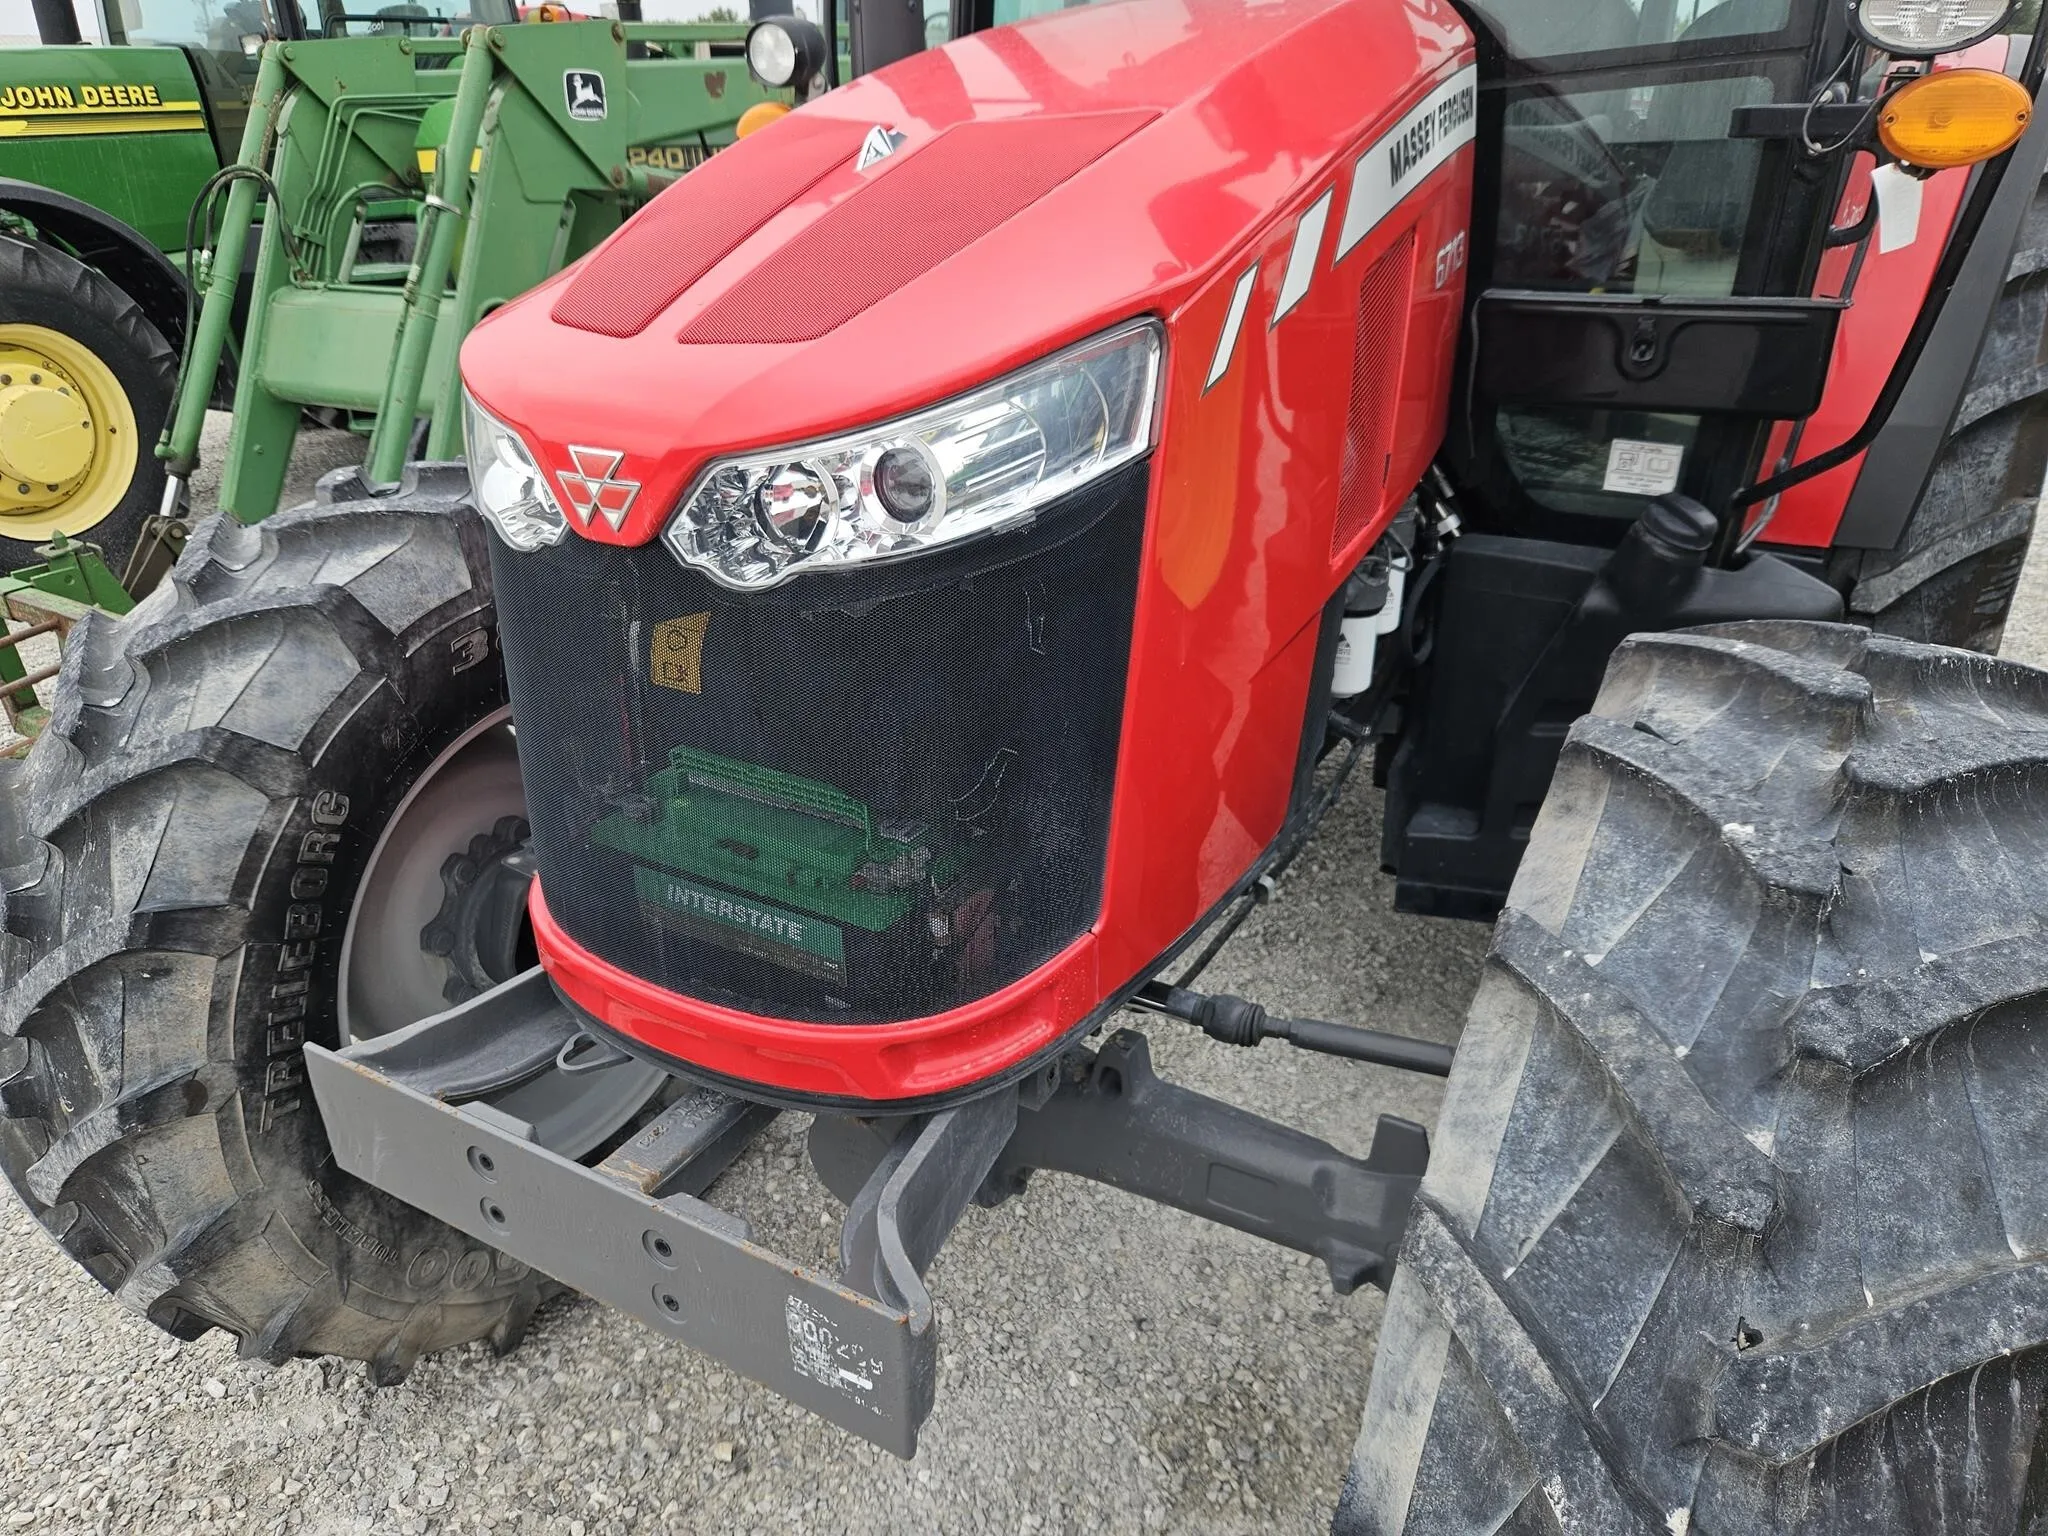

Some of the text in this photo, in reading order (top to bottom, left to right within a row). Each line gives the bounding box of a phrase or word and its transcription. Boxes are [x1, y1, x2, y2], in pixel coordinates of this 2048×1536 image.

[1, 85, 162, 108] JOHN DEERE
[1389, 85, 1474, 188] MASSEY FERGUSON
[1435, 229, 1466, 290] 6713
[667, 883, 803, 942] INTERSTATE
[304, 1178, 399, 1266] TUBELESS
